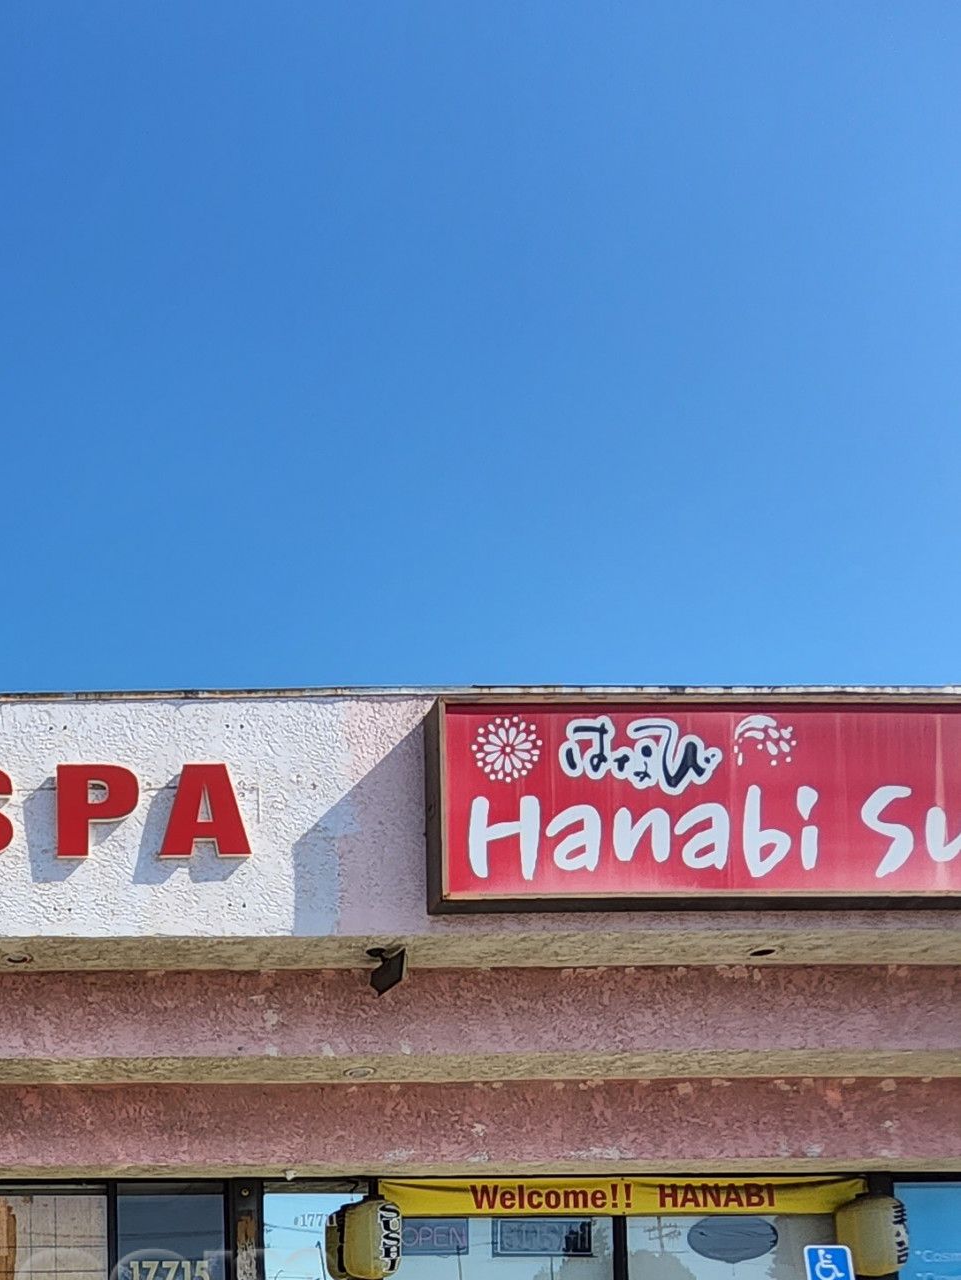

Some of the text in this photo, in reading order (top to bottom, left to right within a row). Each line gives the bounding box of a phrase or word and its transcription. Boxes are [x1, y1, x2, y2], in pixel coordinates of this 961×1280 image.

[468, 785, 961, 881] Hanabi Su
[469, 1182, 776, 1209] Welcome!! HANABI
[377, 1202, 402, 1274] SUSHI
[402, 1225, 467, 1248] OPEN
